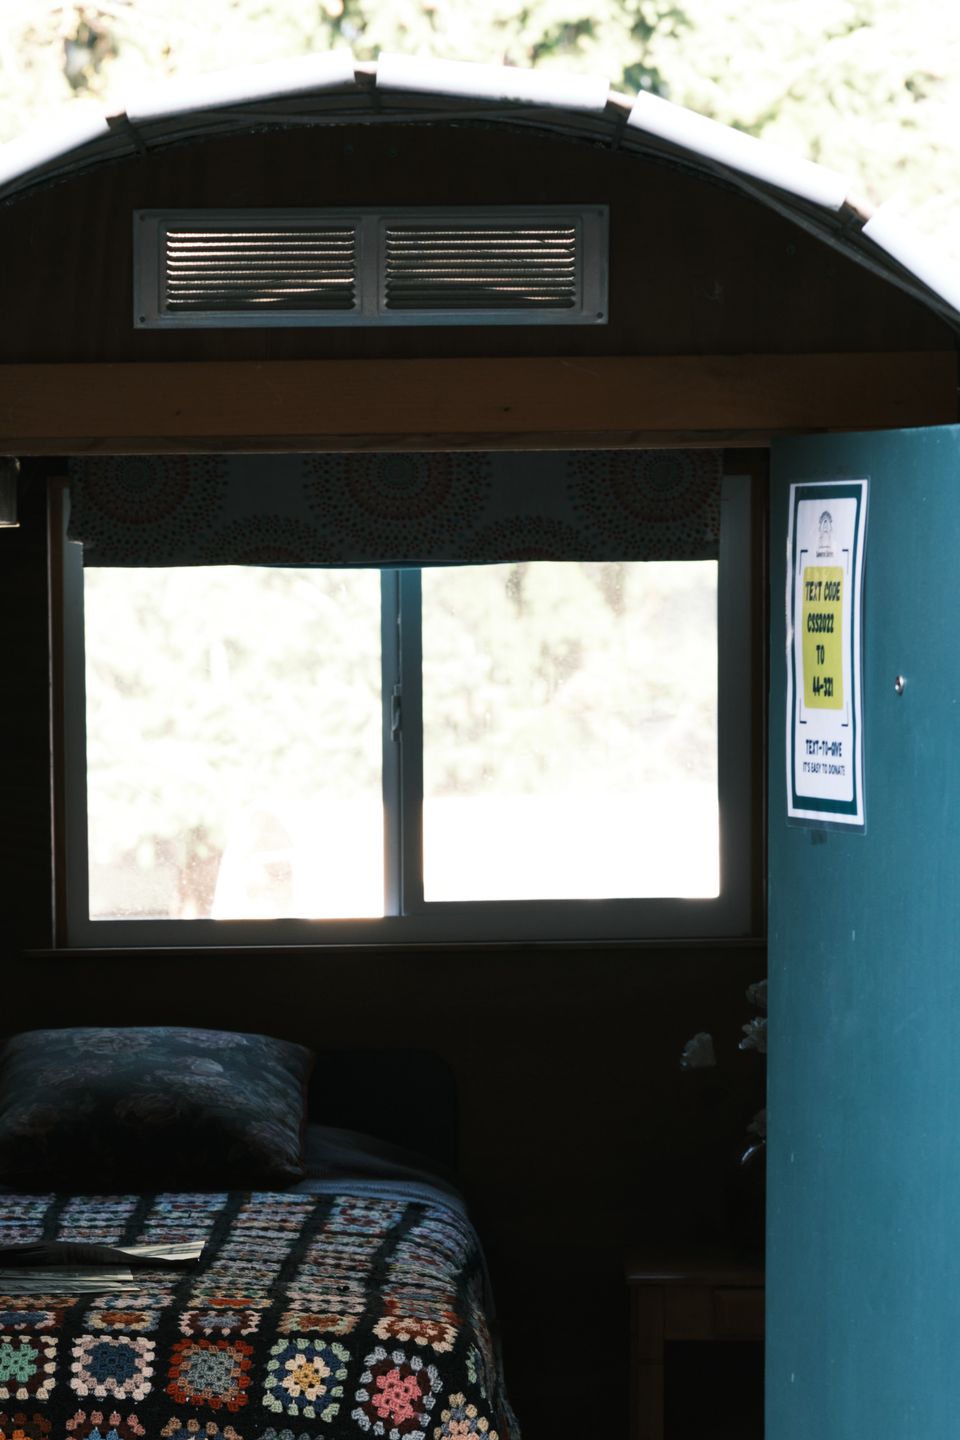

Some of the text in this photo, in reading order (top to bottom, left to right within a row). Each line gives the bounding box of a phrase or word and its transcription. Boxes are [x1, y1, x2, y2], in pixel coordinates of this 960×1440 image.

[805, 581, 841, 601] TEXT CODE
[816, 645, 825, 665] TO
[822, 763, 828, 774] TO
